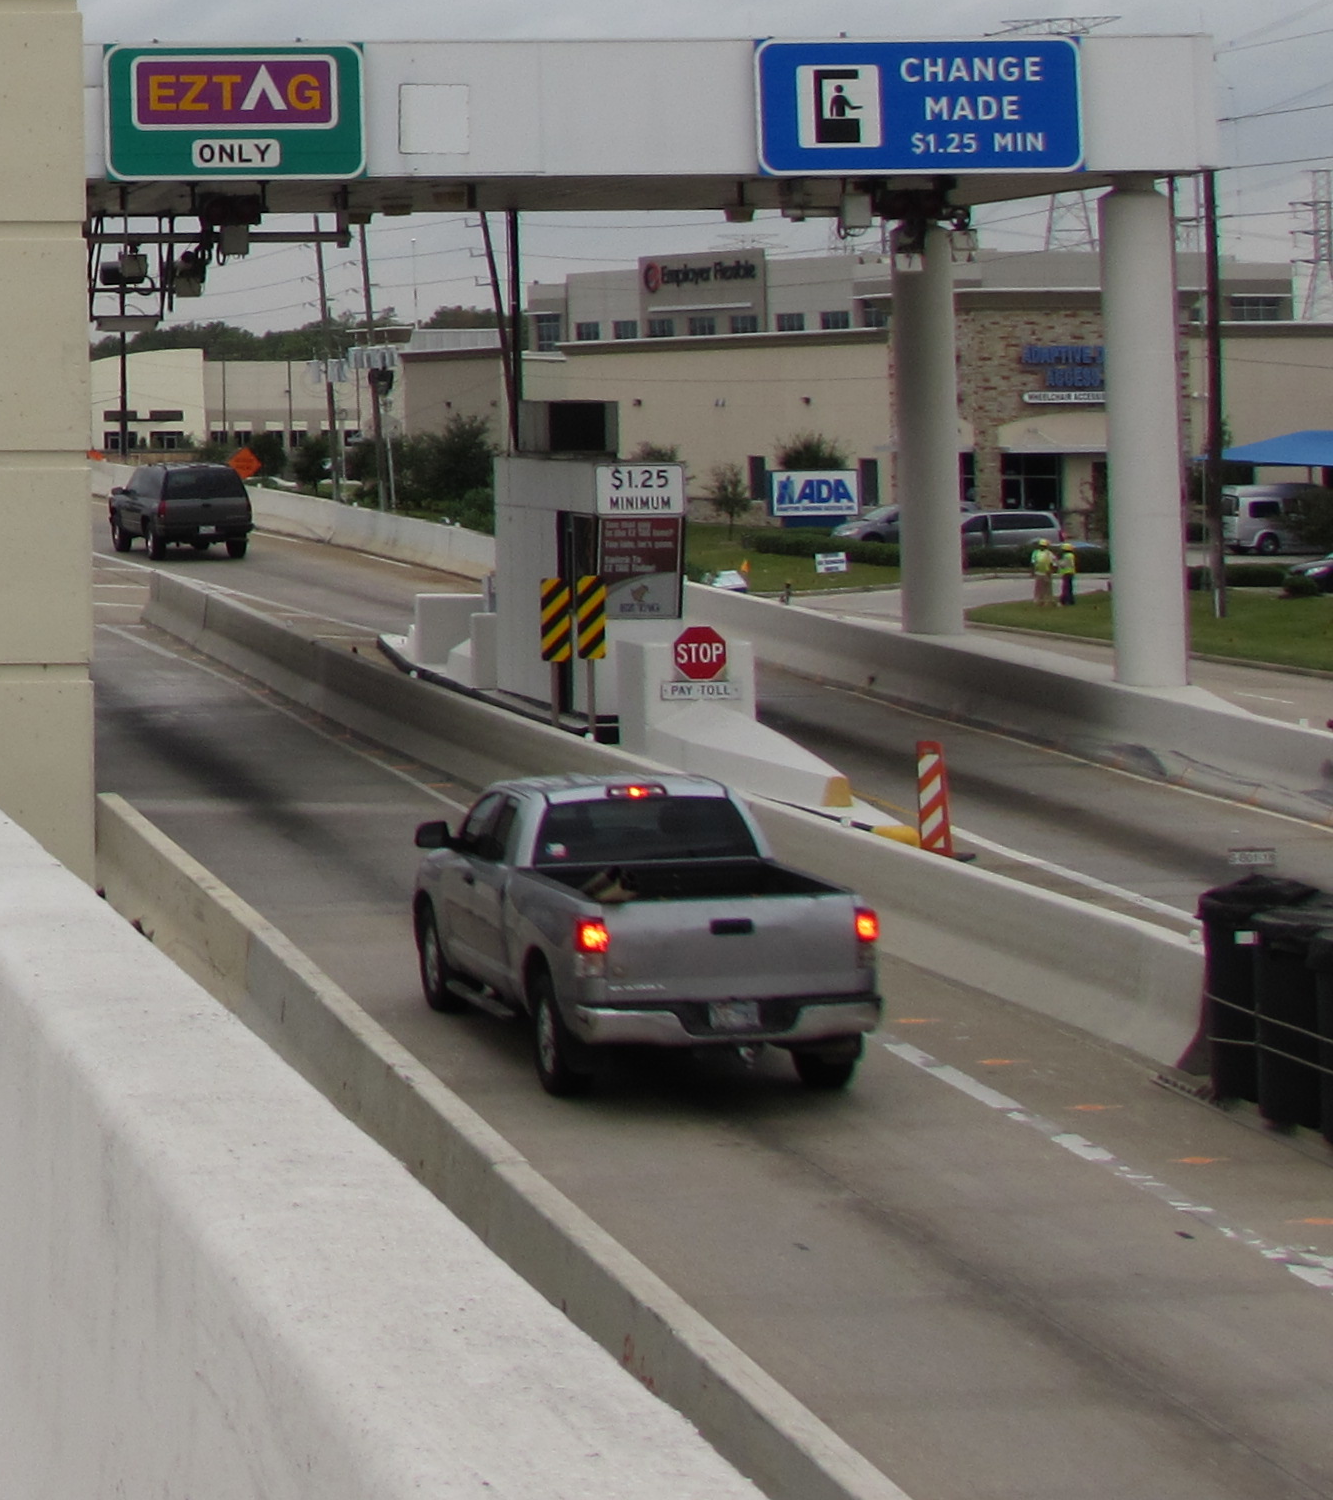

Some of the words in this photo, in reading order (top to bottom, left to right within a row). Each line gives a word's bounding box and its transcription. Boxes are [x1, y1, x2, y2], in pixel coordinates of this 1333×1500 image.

[900, 56, 1043, 83] CHANGE
[925, 95, 1021, 121] MADE
[199, 144, 271, 163] ONLY
[911, 132, 978, 155] $1.25
[993, 132, 1045, 153] MIN
[661, 264, 712, 287] Employer
[611, 468, 669, 490] $1.25
[795, 478, 855, 504] ADA
[609, 496, 671, 510] MINIMUM
[676, 643, 724, 664] STOP
[671, 685, 693, 696] PAY
[700, 684, 730, 696] TOLL
